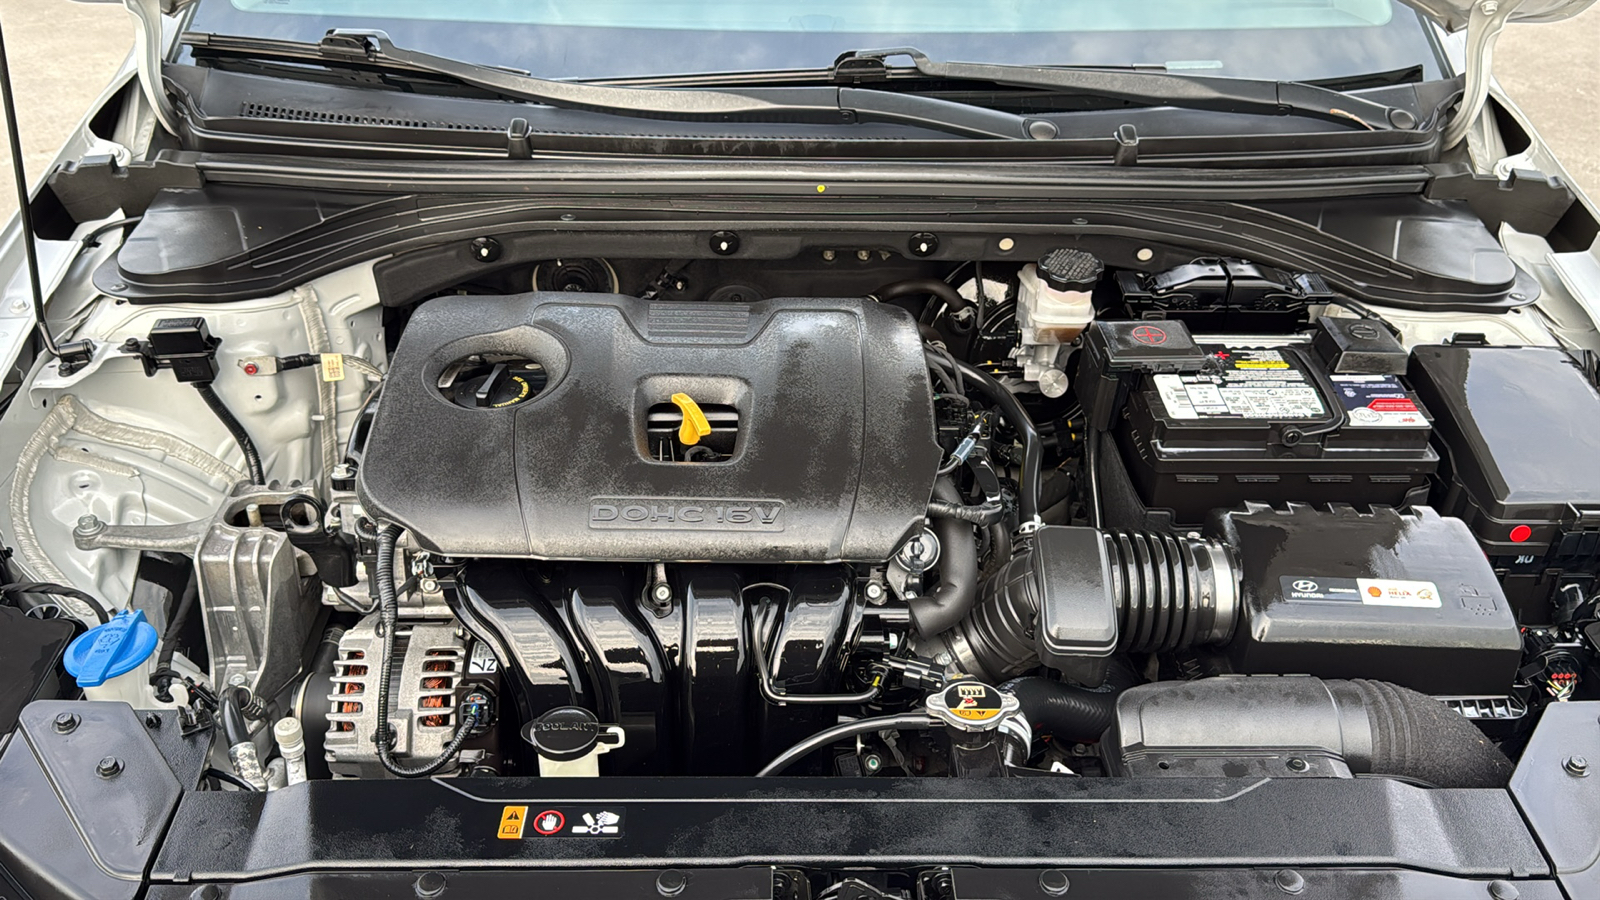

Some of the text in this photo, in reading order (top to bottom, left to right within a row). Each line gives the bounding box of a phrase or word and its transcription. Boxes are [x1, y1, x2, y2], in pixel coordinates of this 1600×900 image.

[592, 504, 782, 524] DOHC 16V
[536, 721, 594, 732] COOLANT
